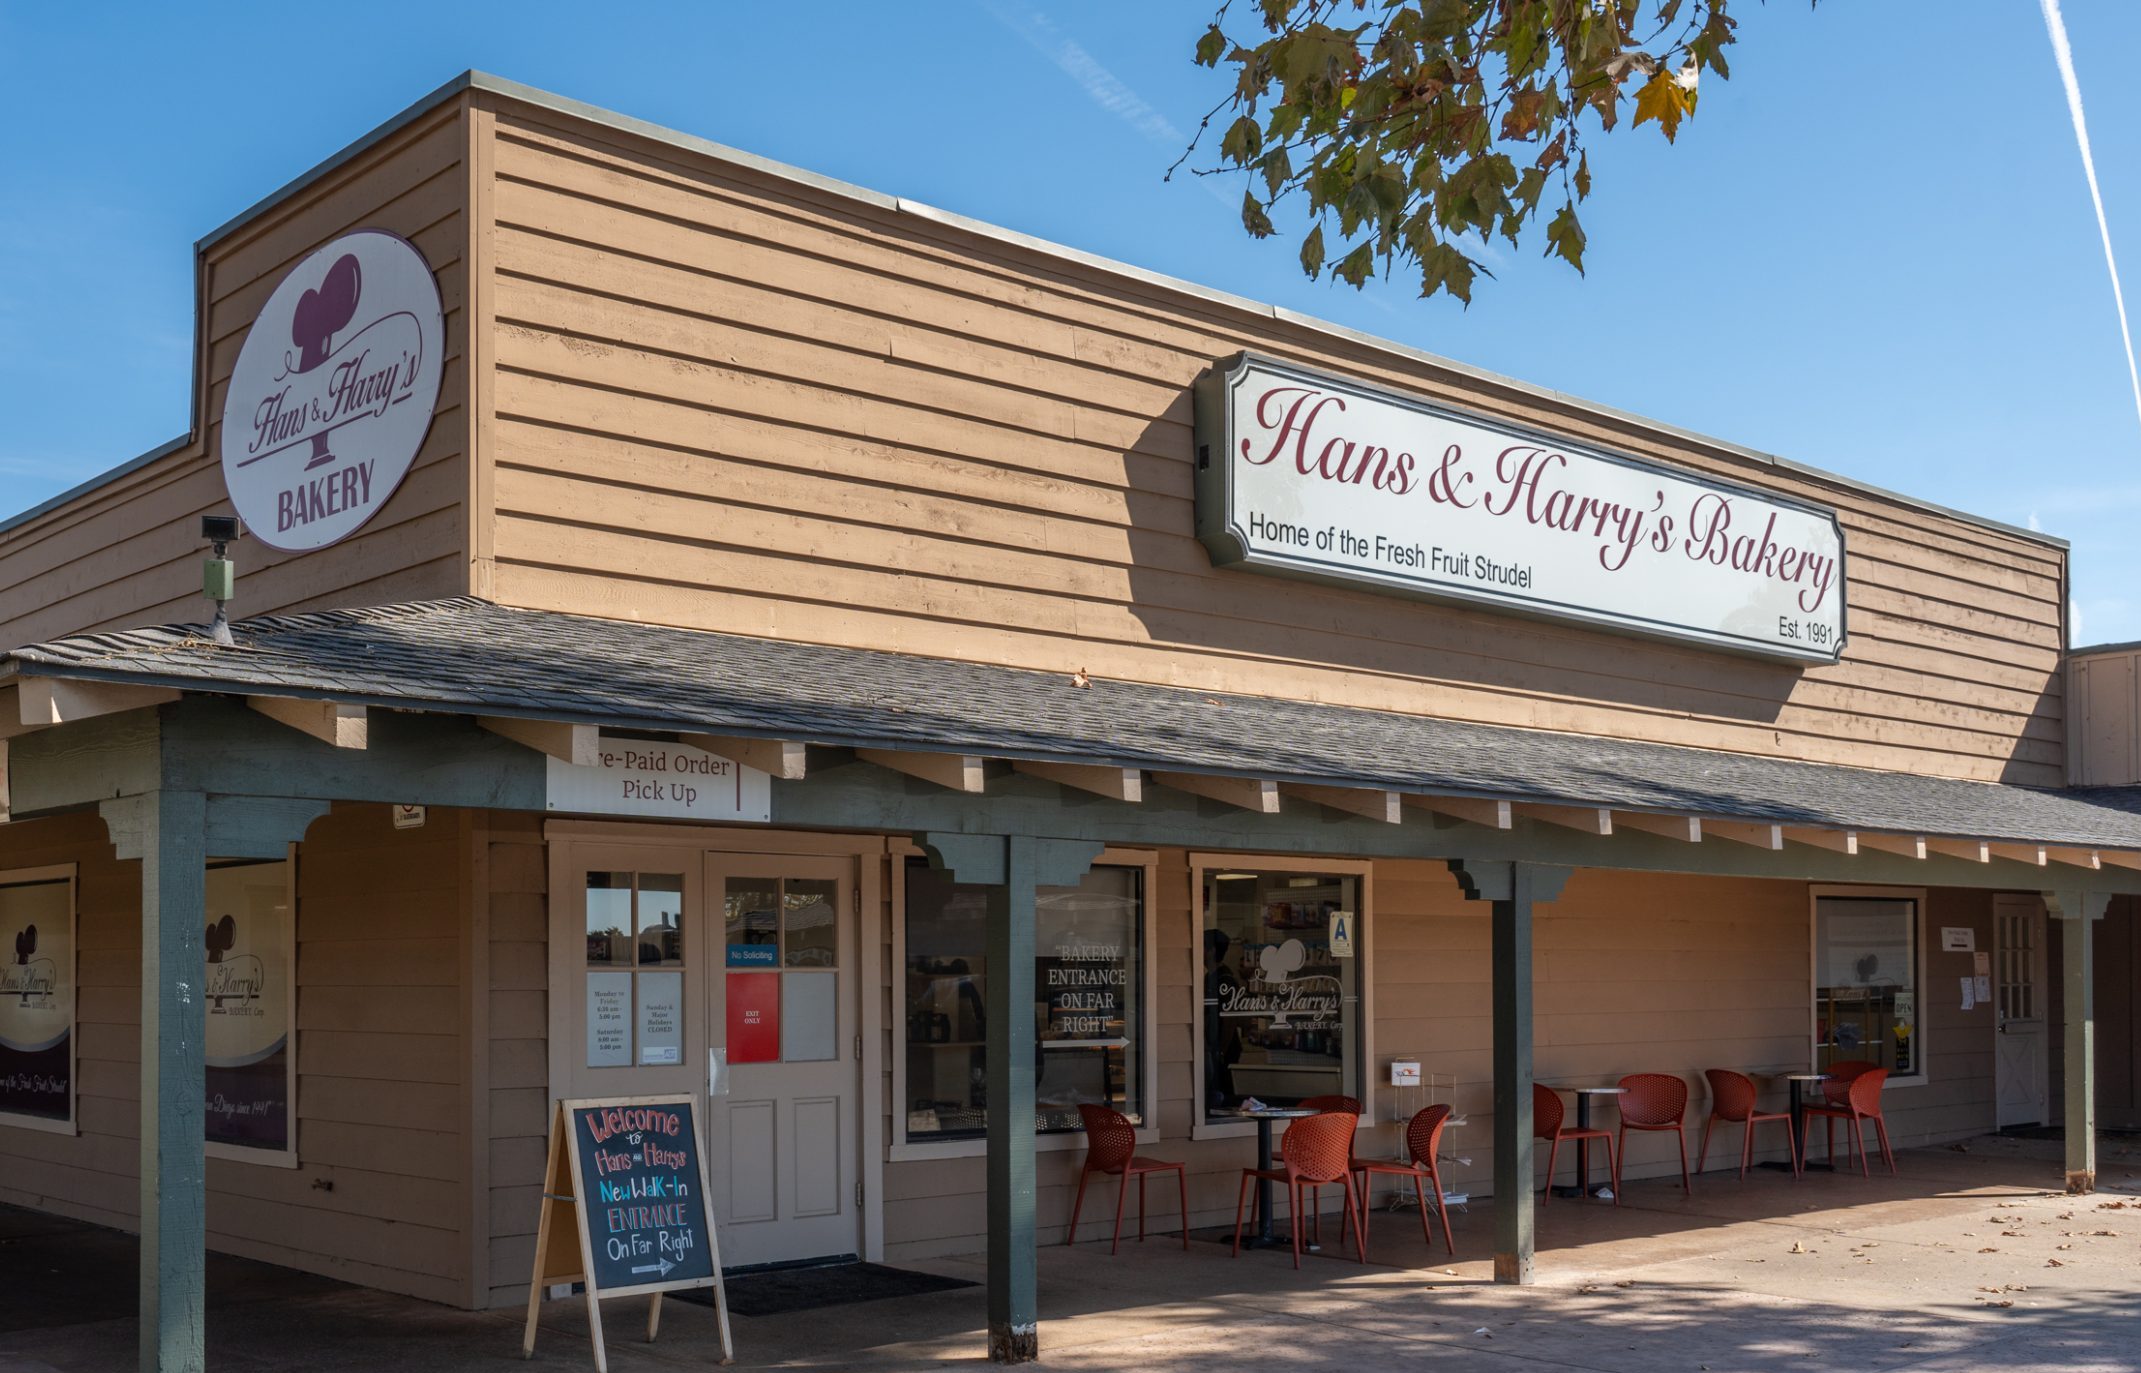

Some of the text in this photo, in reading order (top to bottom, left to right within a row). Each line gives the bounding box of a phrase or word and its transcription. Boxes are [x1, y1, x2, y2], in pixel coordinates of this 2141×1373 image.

[249, 348, 419, 453] Hans & Harry's
[277, 458, 375, 533] BAKERY
[1241, 386, 1836, 613] Hans & Harry's Bakery
[1249, 511, 1533, 590] Home of the Fresh Fruit Strudel
[1779, 614, 1834, 646] Est. 1991
[598, 751, 730, 776] e-Paid Order
[623, 780, 697, 807] Pick Up
[1334, 918, 1347, 940] A
[731, 951, 773, 961] No Soliciting
[1048, 969, 1127, 985] ENTRANCE
[1061, 993, 1115, 1009] ON FAR
[1219, 982, 1338, 1021] Hans & Harry's
[1896, 1003, 1912, 1013] OPEN
[586, 1106, 680, 1143] Welcome
[625, 1131, 643, 1145] to
[594, 1149, 633, 1176] Hans
[600, 1180, 631, 1203] New
[607, 1203, 688, 1233] ENTRANCE
[607, 1229, 694, 1261] On Far Right
